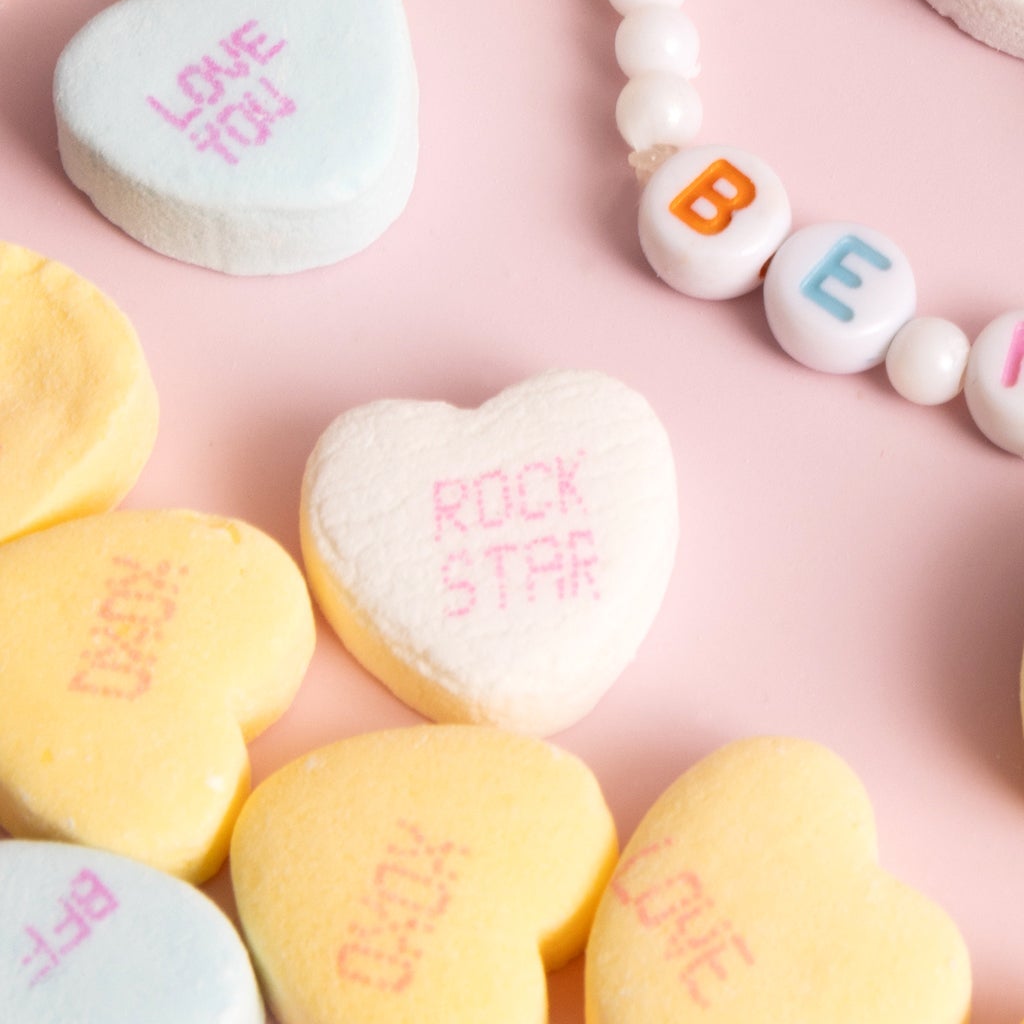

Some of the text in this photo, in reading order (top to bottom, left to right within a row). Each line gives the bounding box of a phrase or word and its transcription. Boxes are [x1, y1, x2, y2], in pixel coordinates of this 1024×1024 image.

[145, 19, 286, 130] LOVE
[190, 76, 297, 165] YOU
[668, 157, 892, 323] BE
[433, 450, 587, 542] ROCK
[68, 556, 189, 701] XOXO
[442, 530, 601, 618] STAR
[21, 868, 119, 987] BFF
[336, 819, 470, 994] XOXO
[610, 837, 755, 1010] LOVE
